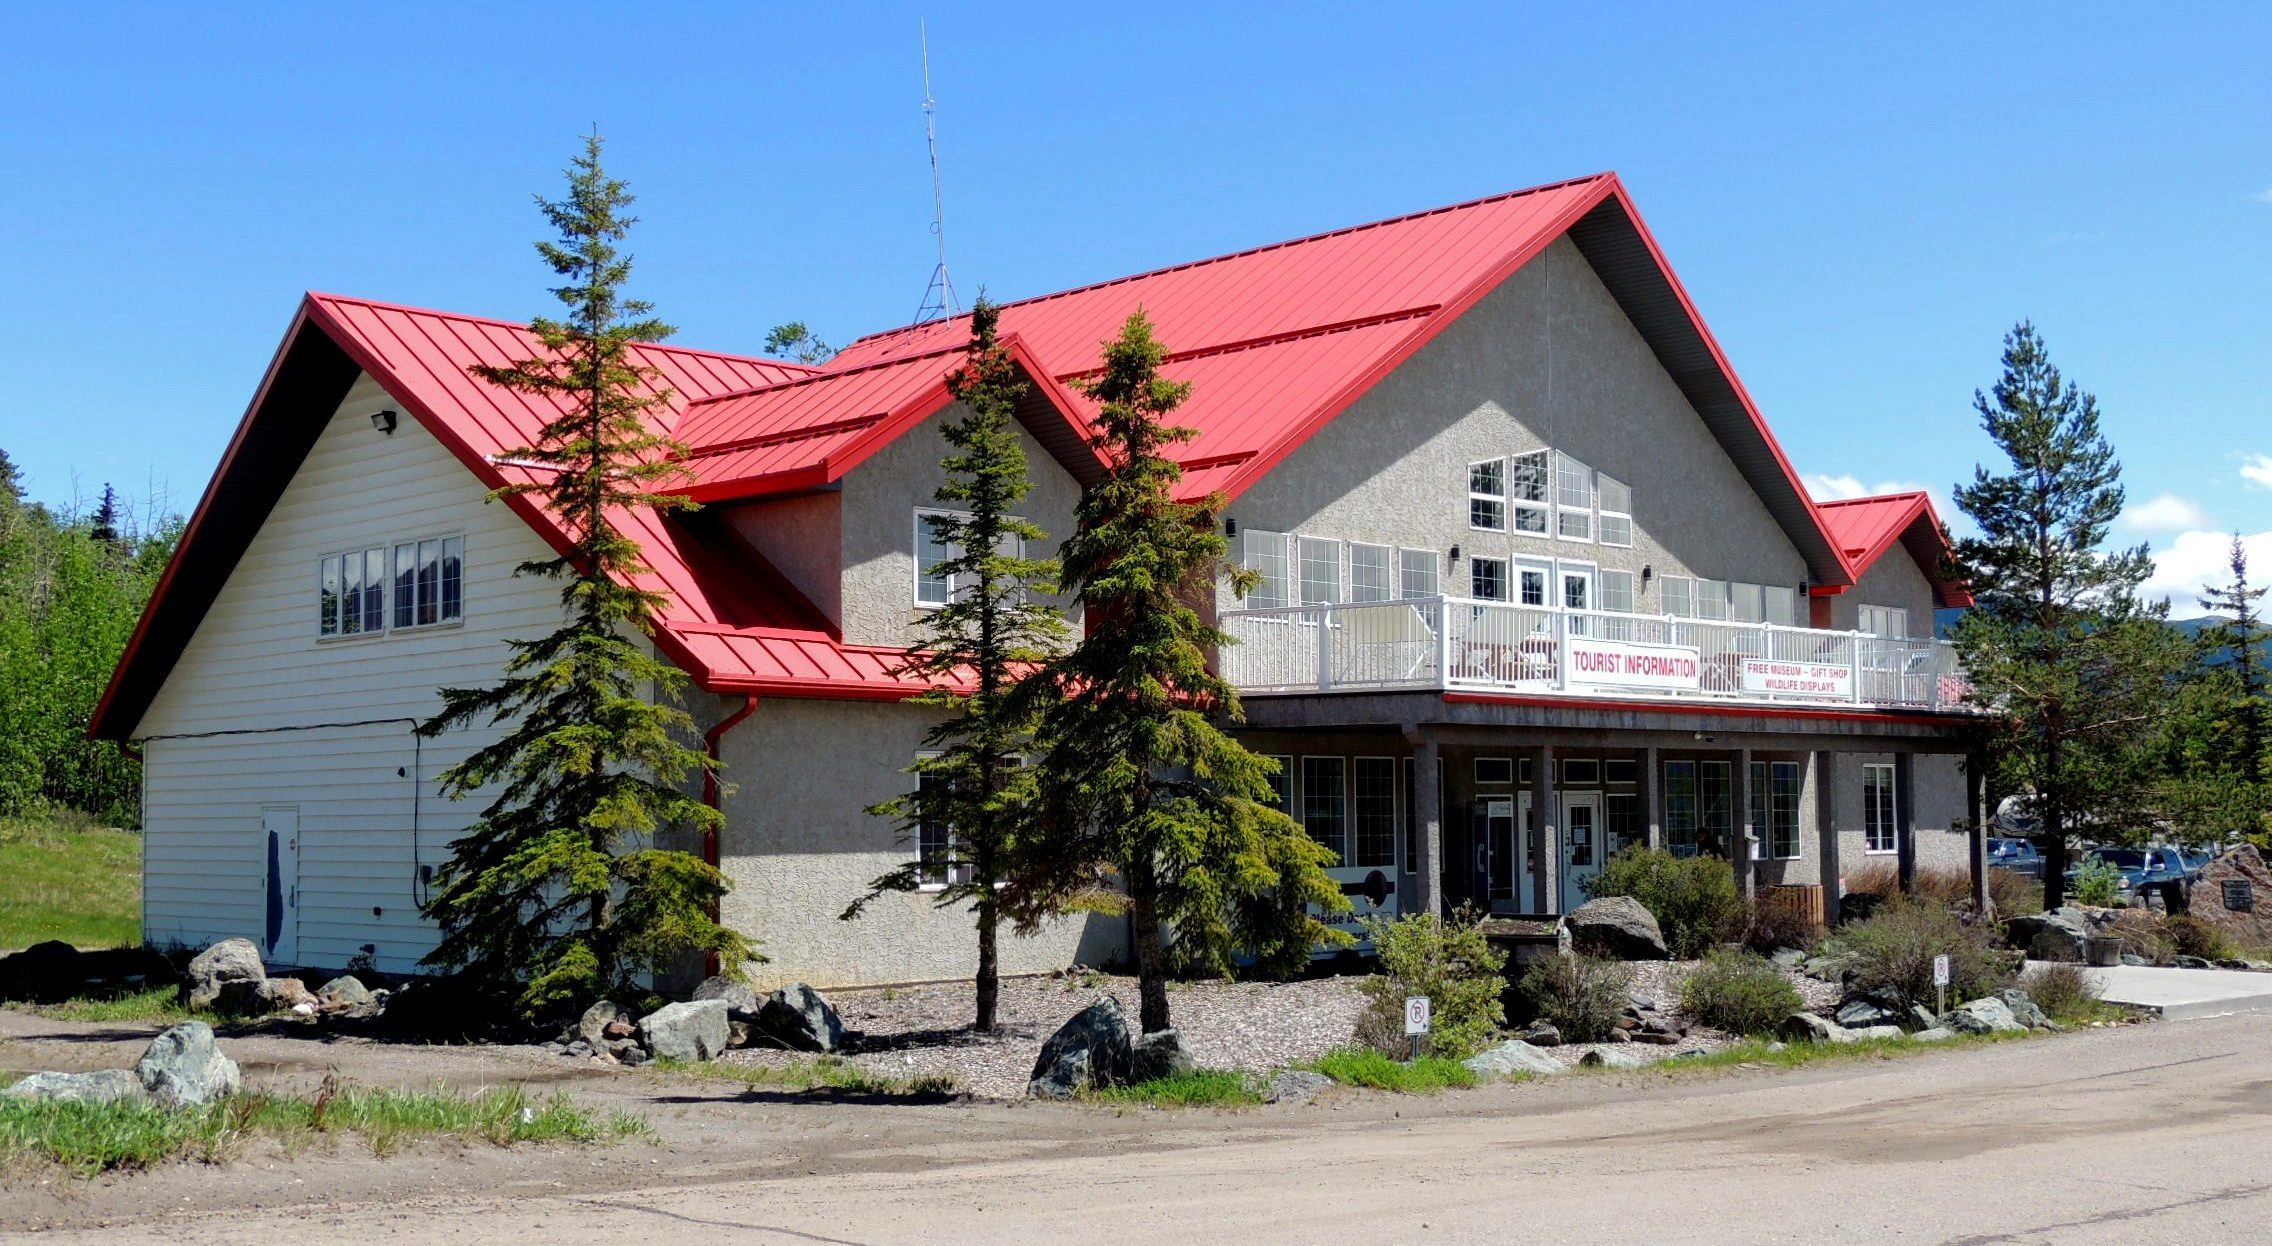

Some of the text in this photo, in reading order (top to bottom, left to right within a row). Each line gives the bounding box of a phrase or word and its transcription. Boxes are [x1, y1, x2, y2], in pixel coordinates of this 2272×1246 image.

[1573, 650, 1696, 678] TOURIST INFORMATION
[1747, 663, 1769, 674] FREE
[1770, 664, 1801, 676] MUSEUM
[1811, 667, 1828, 678] GIFT
[1829, 668, 1848, 679] SHOP
[1765, 679, 1835, 692] WILDLIFE DISPLAYS
